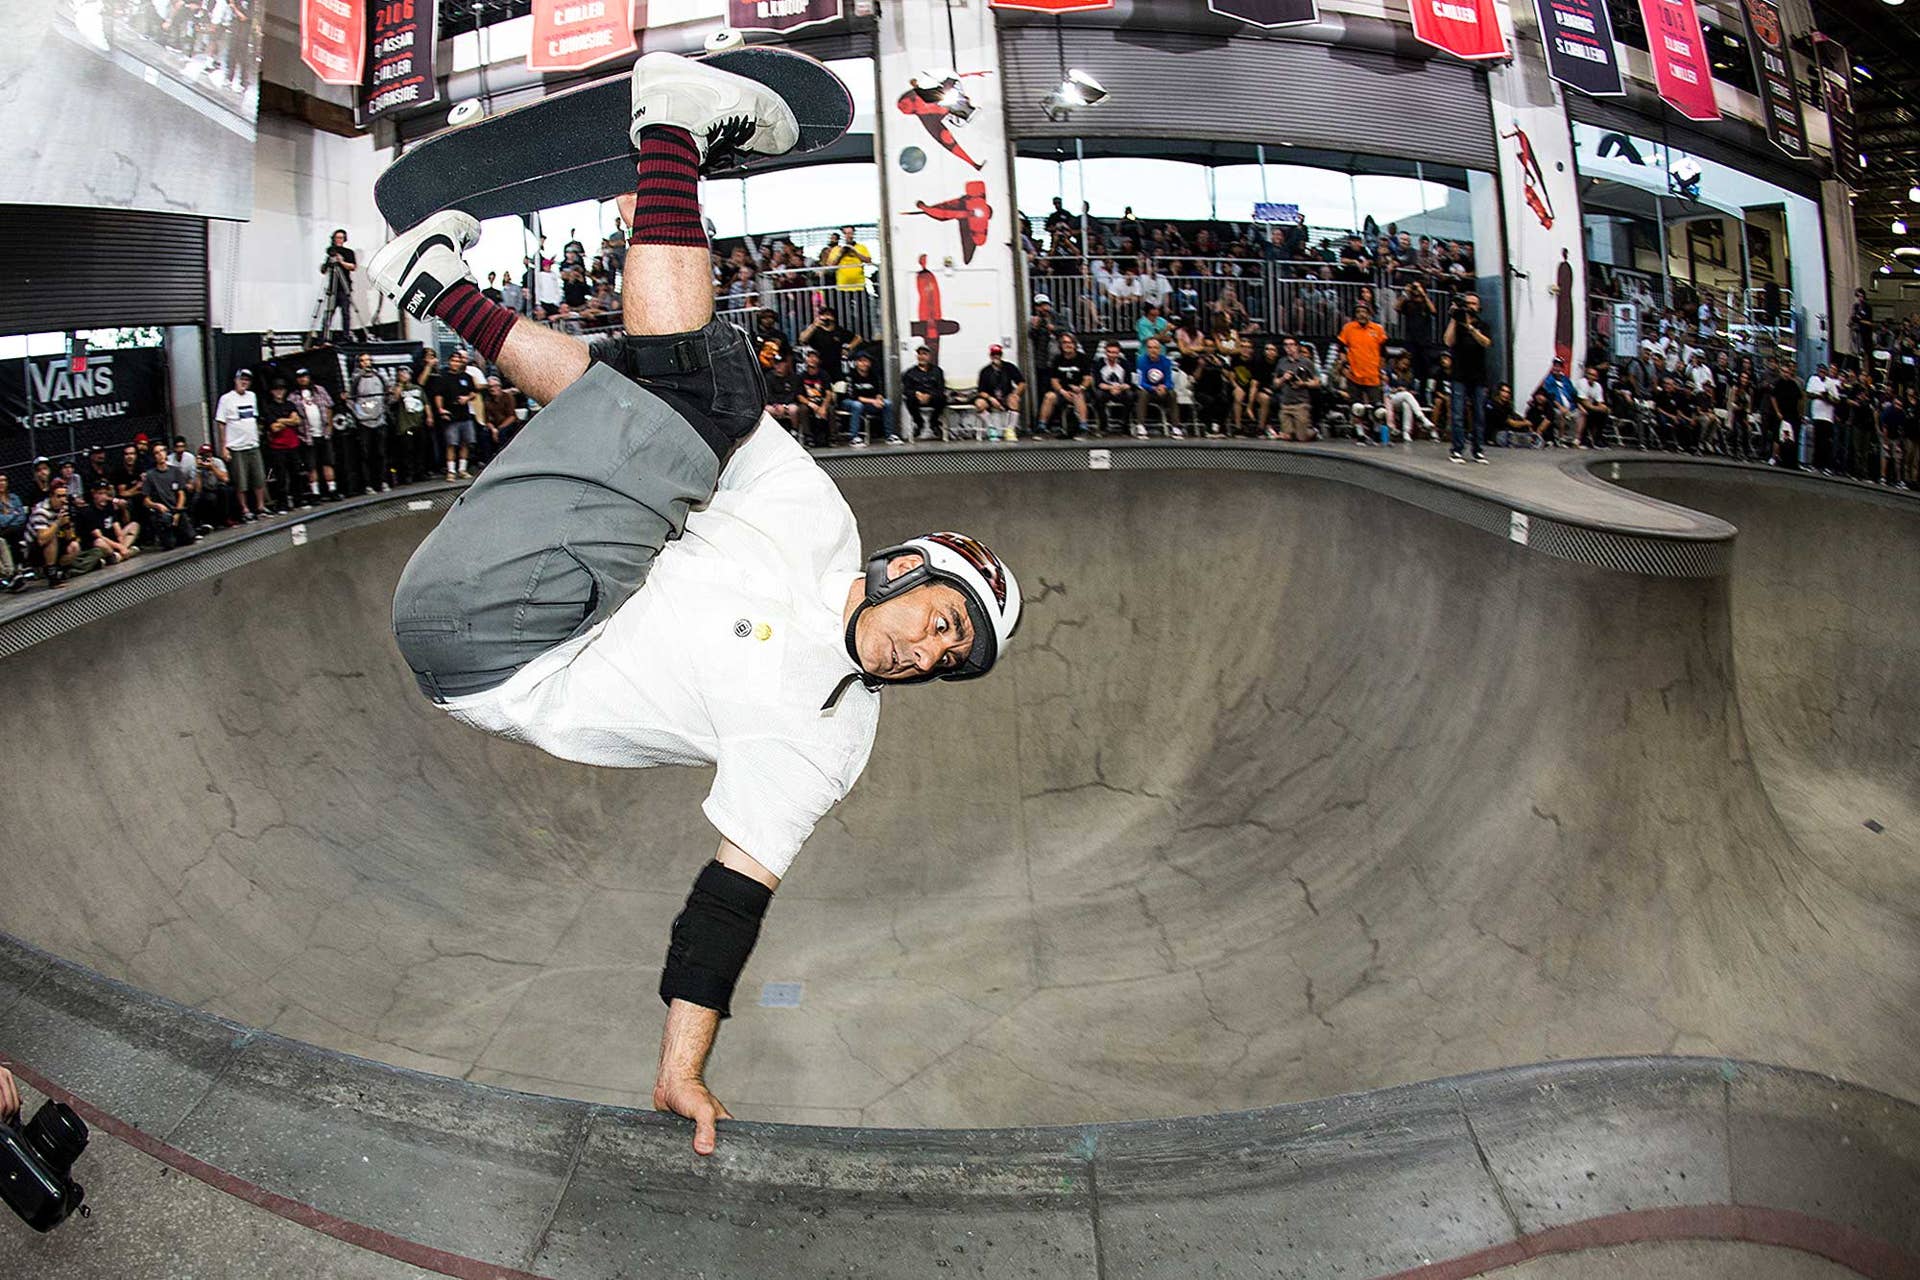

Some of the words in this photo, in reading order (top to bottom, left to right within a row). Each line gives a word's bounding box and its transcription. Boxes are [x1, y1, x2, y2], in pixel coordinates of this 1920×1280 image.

[406, 288, 427, 315] NIKE
[30, 355, 113, 402] VANS
[56, 407, 84, 425] THE
